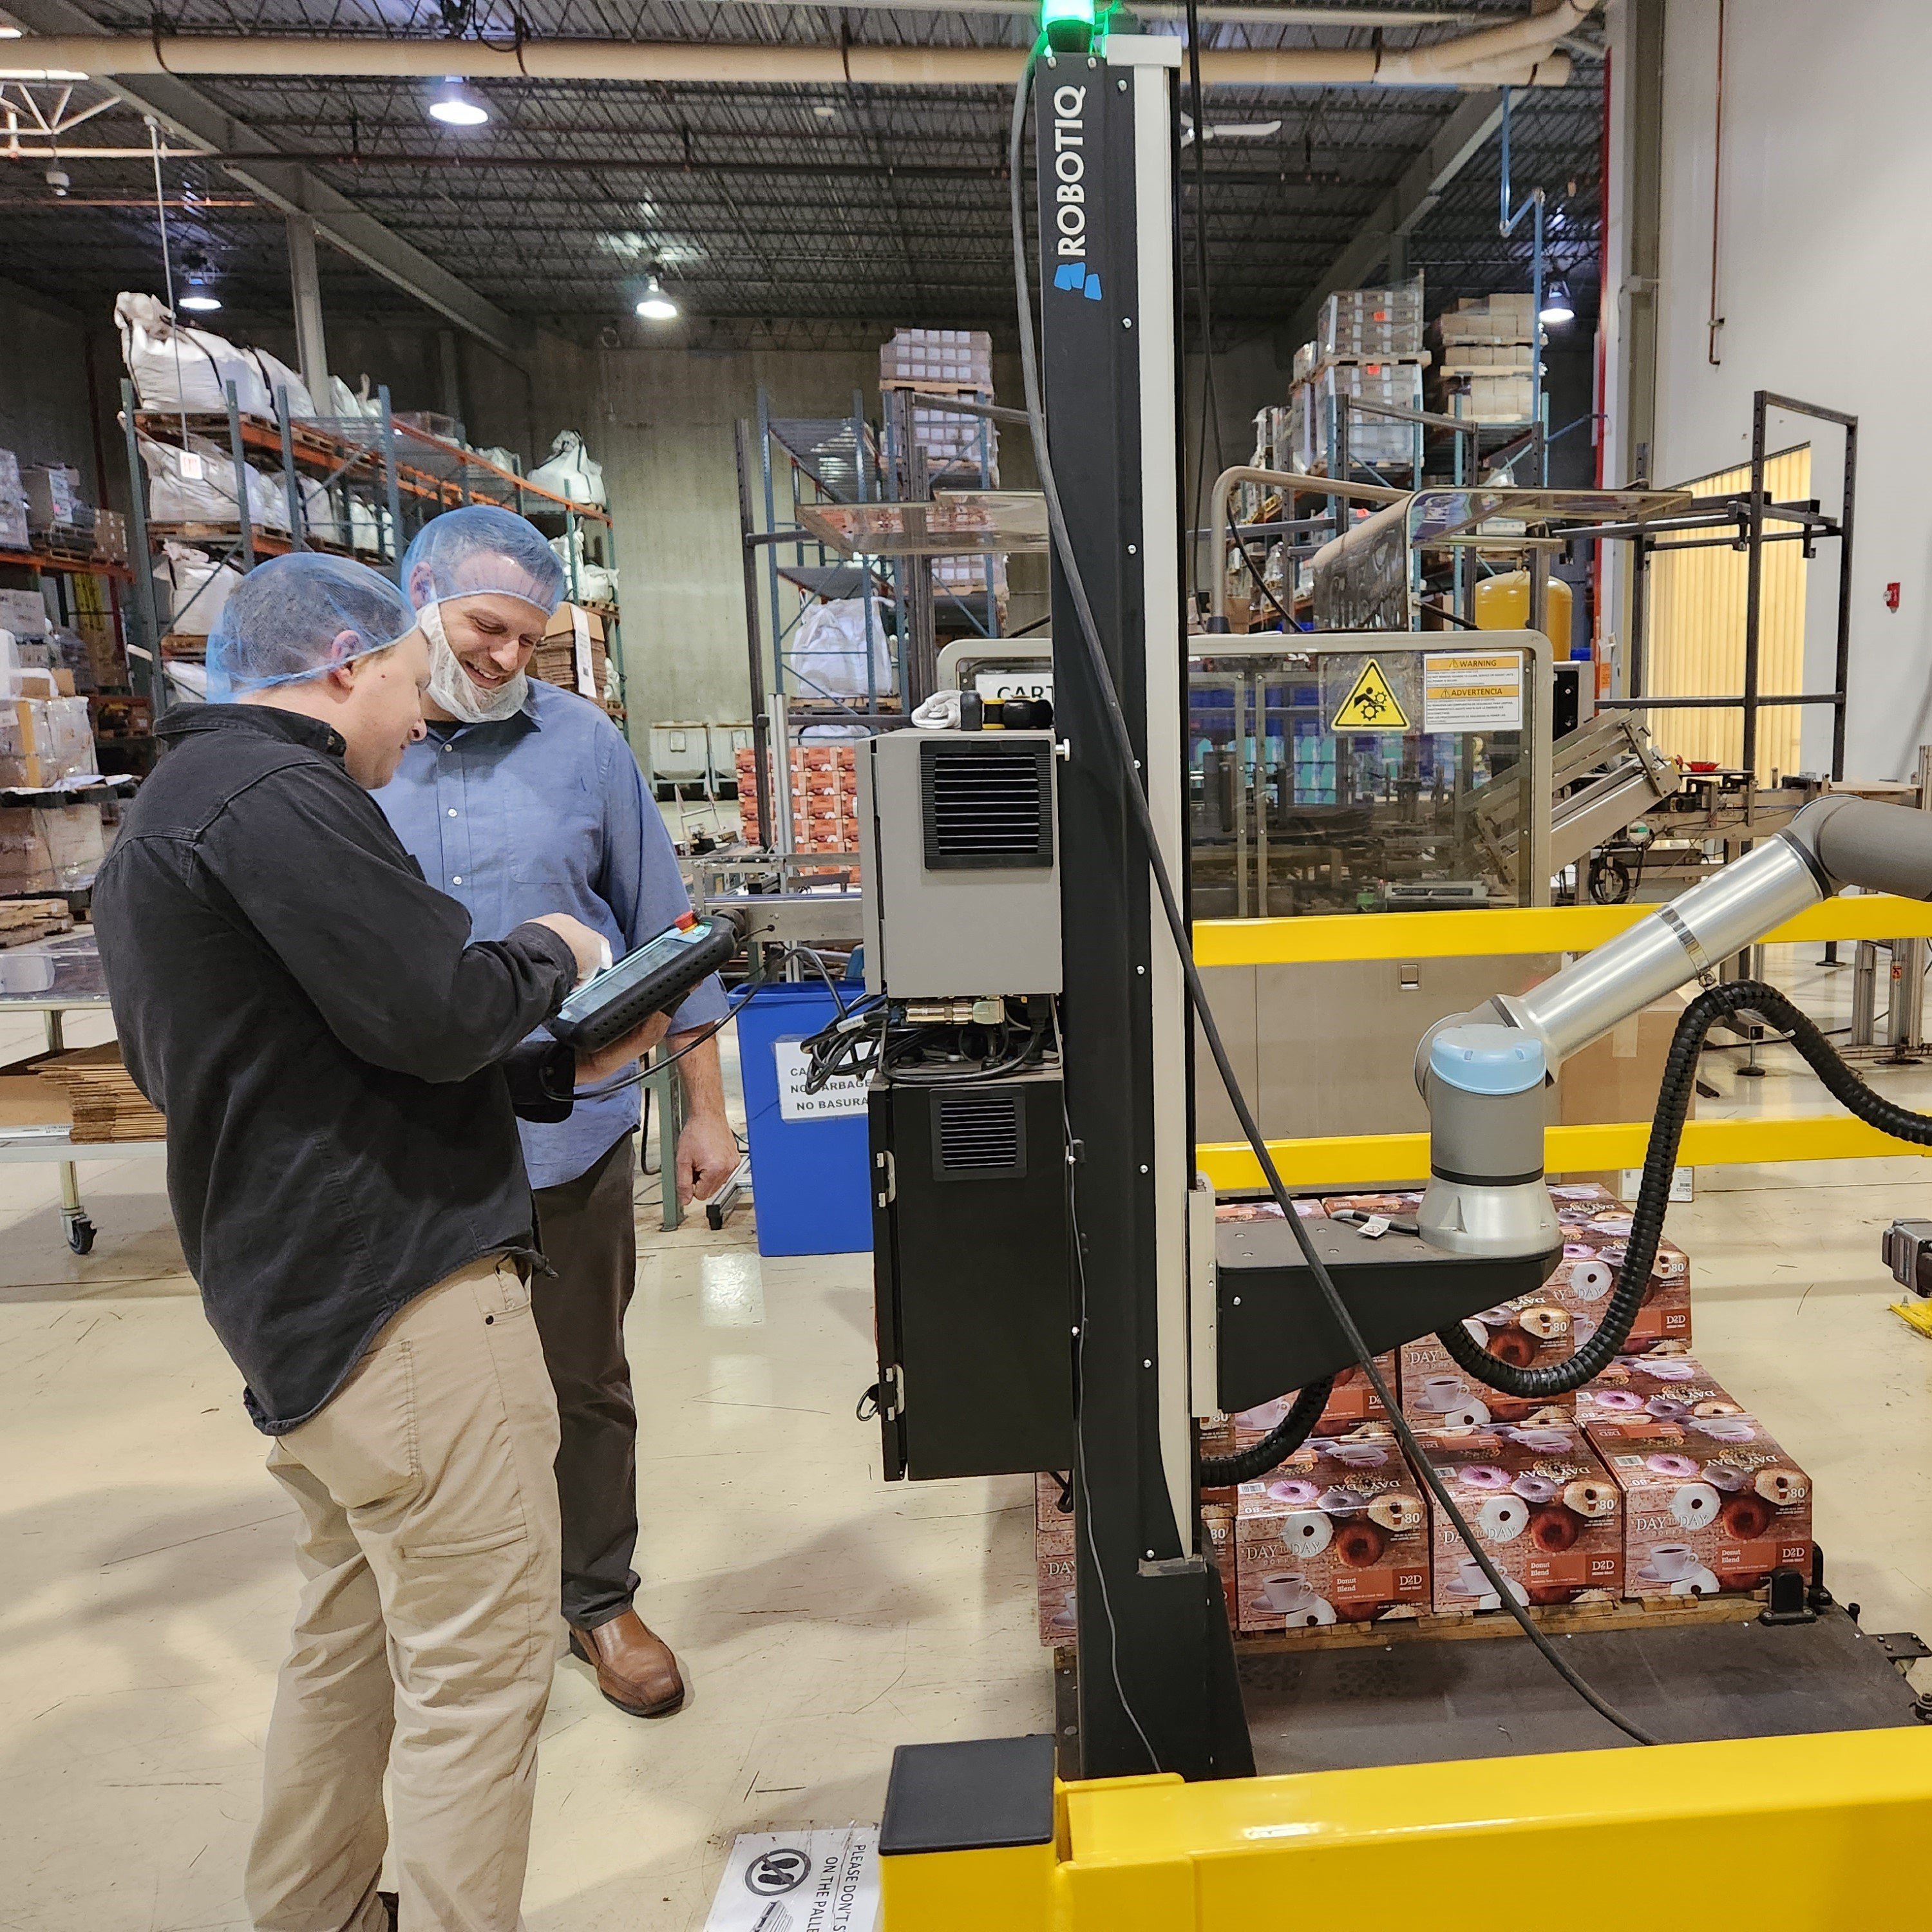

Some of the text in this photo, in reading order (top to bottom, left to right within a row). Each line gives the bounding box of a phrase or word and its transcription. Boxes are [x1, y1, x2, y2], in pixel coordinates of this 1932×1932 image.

[1054, 84, 1086, 256] ROBOTIQ
[1451, 688, 1503, 696] ADVERTENCIA
[815, 1079, 871, 1092] ARBAGE
[796, 1097, 868, 1111] NO BASURA
[1671, 1263, 1684, 1273] 80
[1578, 1287, 1603, 1298] DAY
[1666, 1315, 1685, 1324] D2D
[1553, 1321, 1567, 1332] 80
[1410, 1350, 1439, 1364] DAY
[1368, 1395, 1382, 1405] D2
[1706, 1458, 1736, 1466] DAY
[1748, 1455, 1780, 1464] DAY
[1519, 1470, 1548, 1479] DAY
[1560, 1467, 1592, 1475] DAY
[1327, 1484, 1358, 1493] DAY
[1370, 1480, 1402, 1489] DAY
[1790, 1487, 1805, 1498] 80
[1598, 1499, 1615, 1510] 80
[1405, 1512, 1420, 1524] 80
[1636, 1517, 1667, 1531] DAY
[1678, 1514, 1709, 1527] DAY
[1211, 1528, 1226, 1539] 80
[1487, 1526, 1517, 1539] DAY
[1246, 1544, 1278, 1560] DAY
[1291, 1541, 1321, 1555] DAY
[1783, 1548, 1804, 1558] D2D
[1592, 1560, 1615, 1571] D2D
[1399, 1575, 1423, 1586] D2D
[822, 1857, 838, 1873] ON
[845, 1844, 867, 1882] PLEASE
[816, 1875, 834, 1897] THE
[835, 1885, 857, 1922] DON'T
